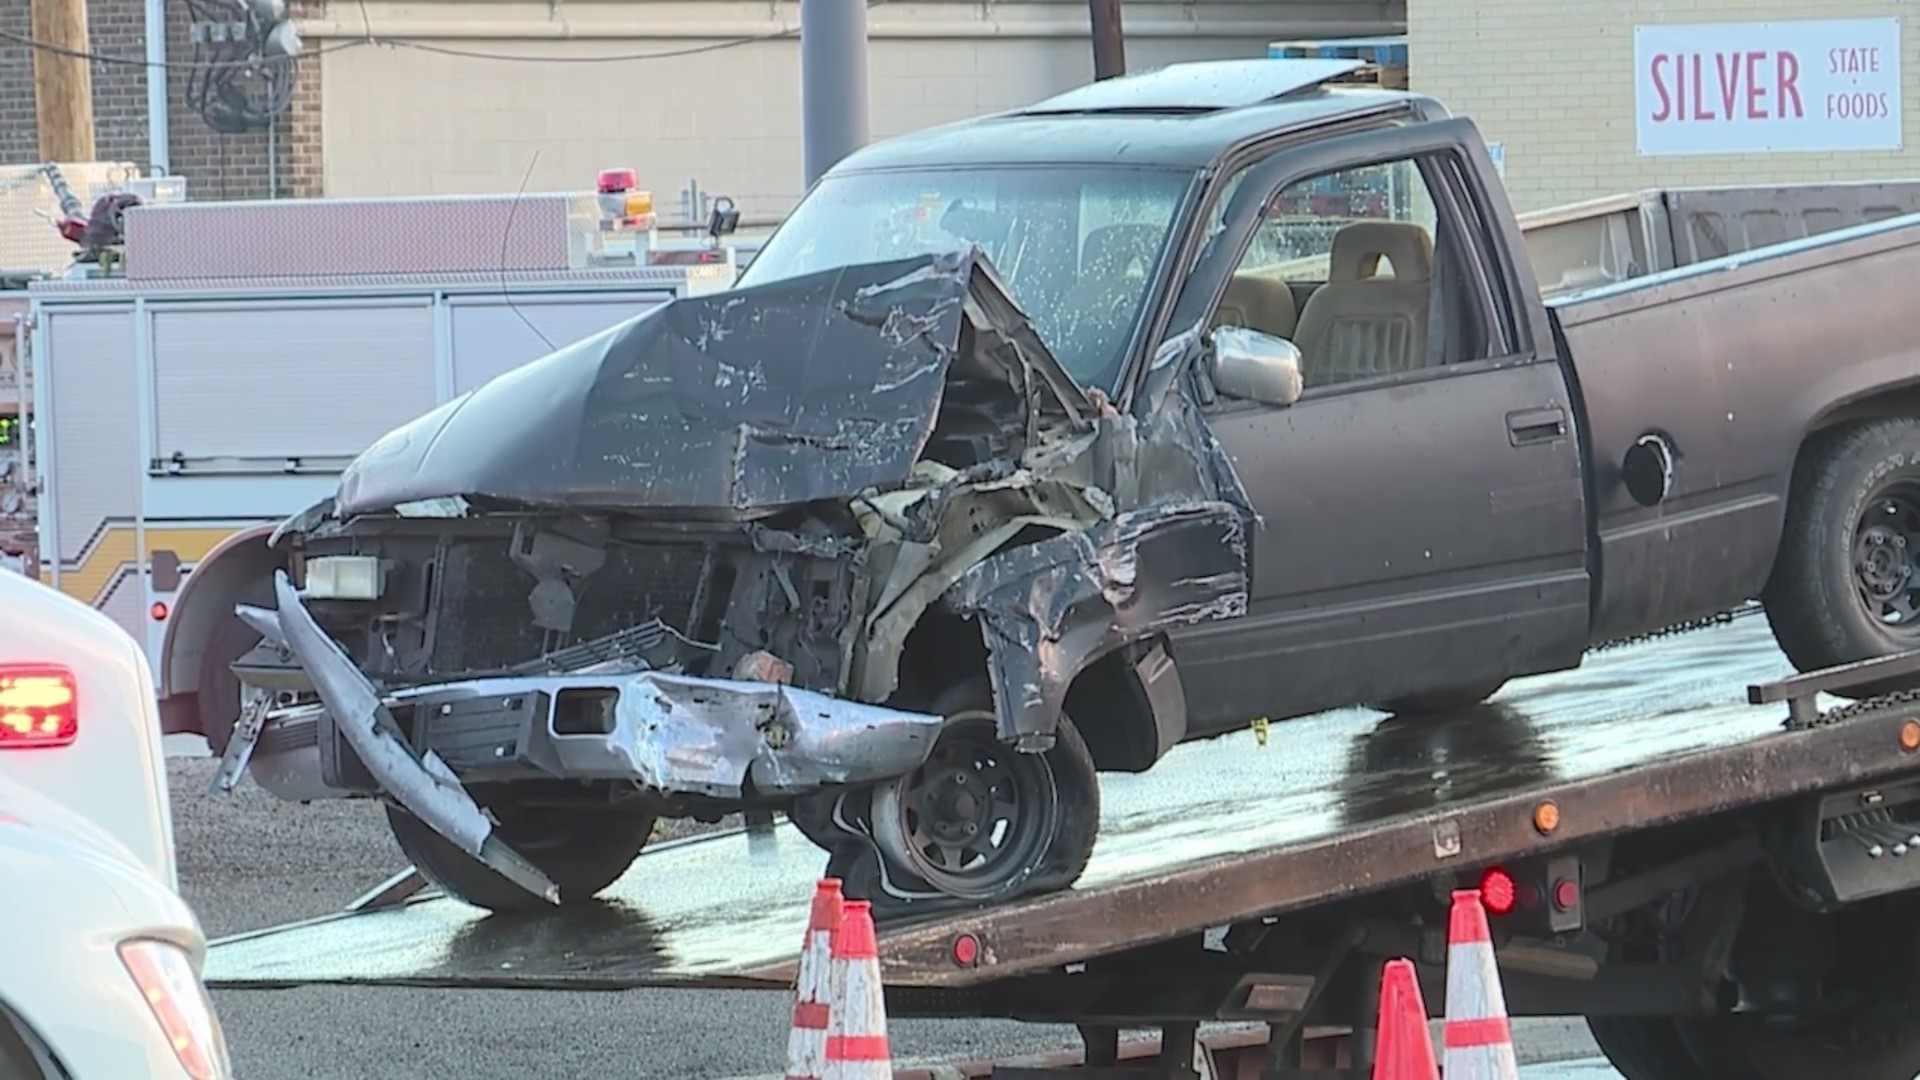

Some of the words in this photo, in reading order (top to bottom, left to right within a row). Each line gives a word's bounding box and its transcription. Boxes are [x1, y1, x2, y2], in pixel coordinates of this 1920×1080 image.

[1829, 47, 1880, 74] STATE
[1650, 51, 1804, 122] SILVER
[1827, 92, 1889, 119] FOODS
